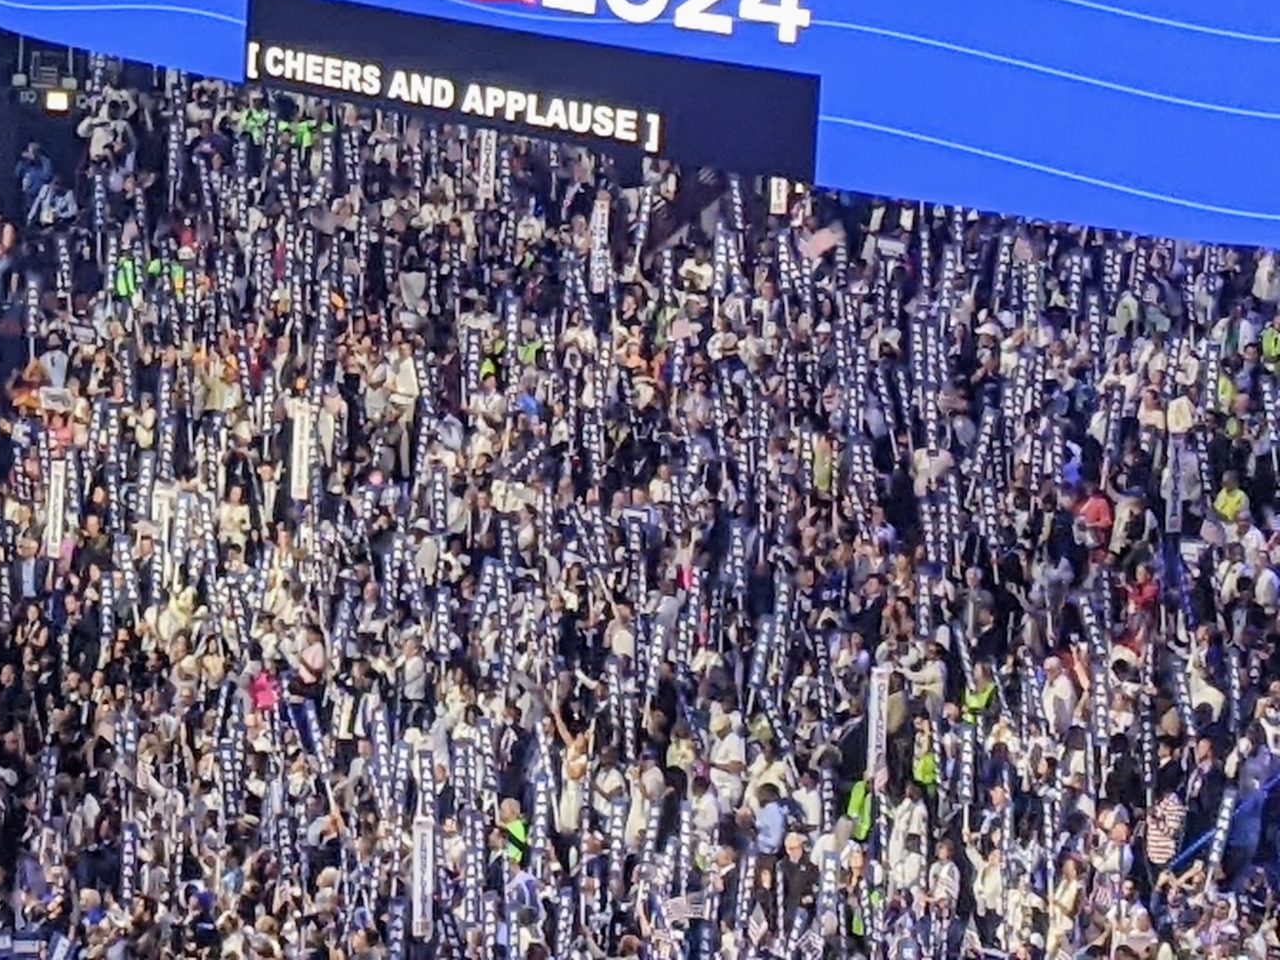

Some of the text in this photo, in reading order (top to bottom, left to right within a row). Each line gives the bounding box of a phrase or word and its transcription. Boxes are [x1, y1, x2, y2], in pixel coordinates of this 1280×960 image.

[265, 44, 382, 96] CHEERS
[387, 71, 456, 109] AND
[461, 84, 638, 142] APPLAUSE
